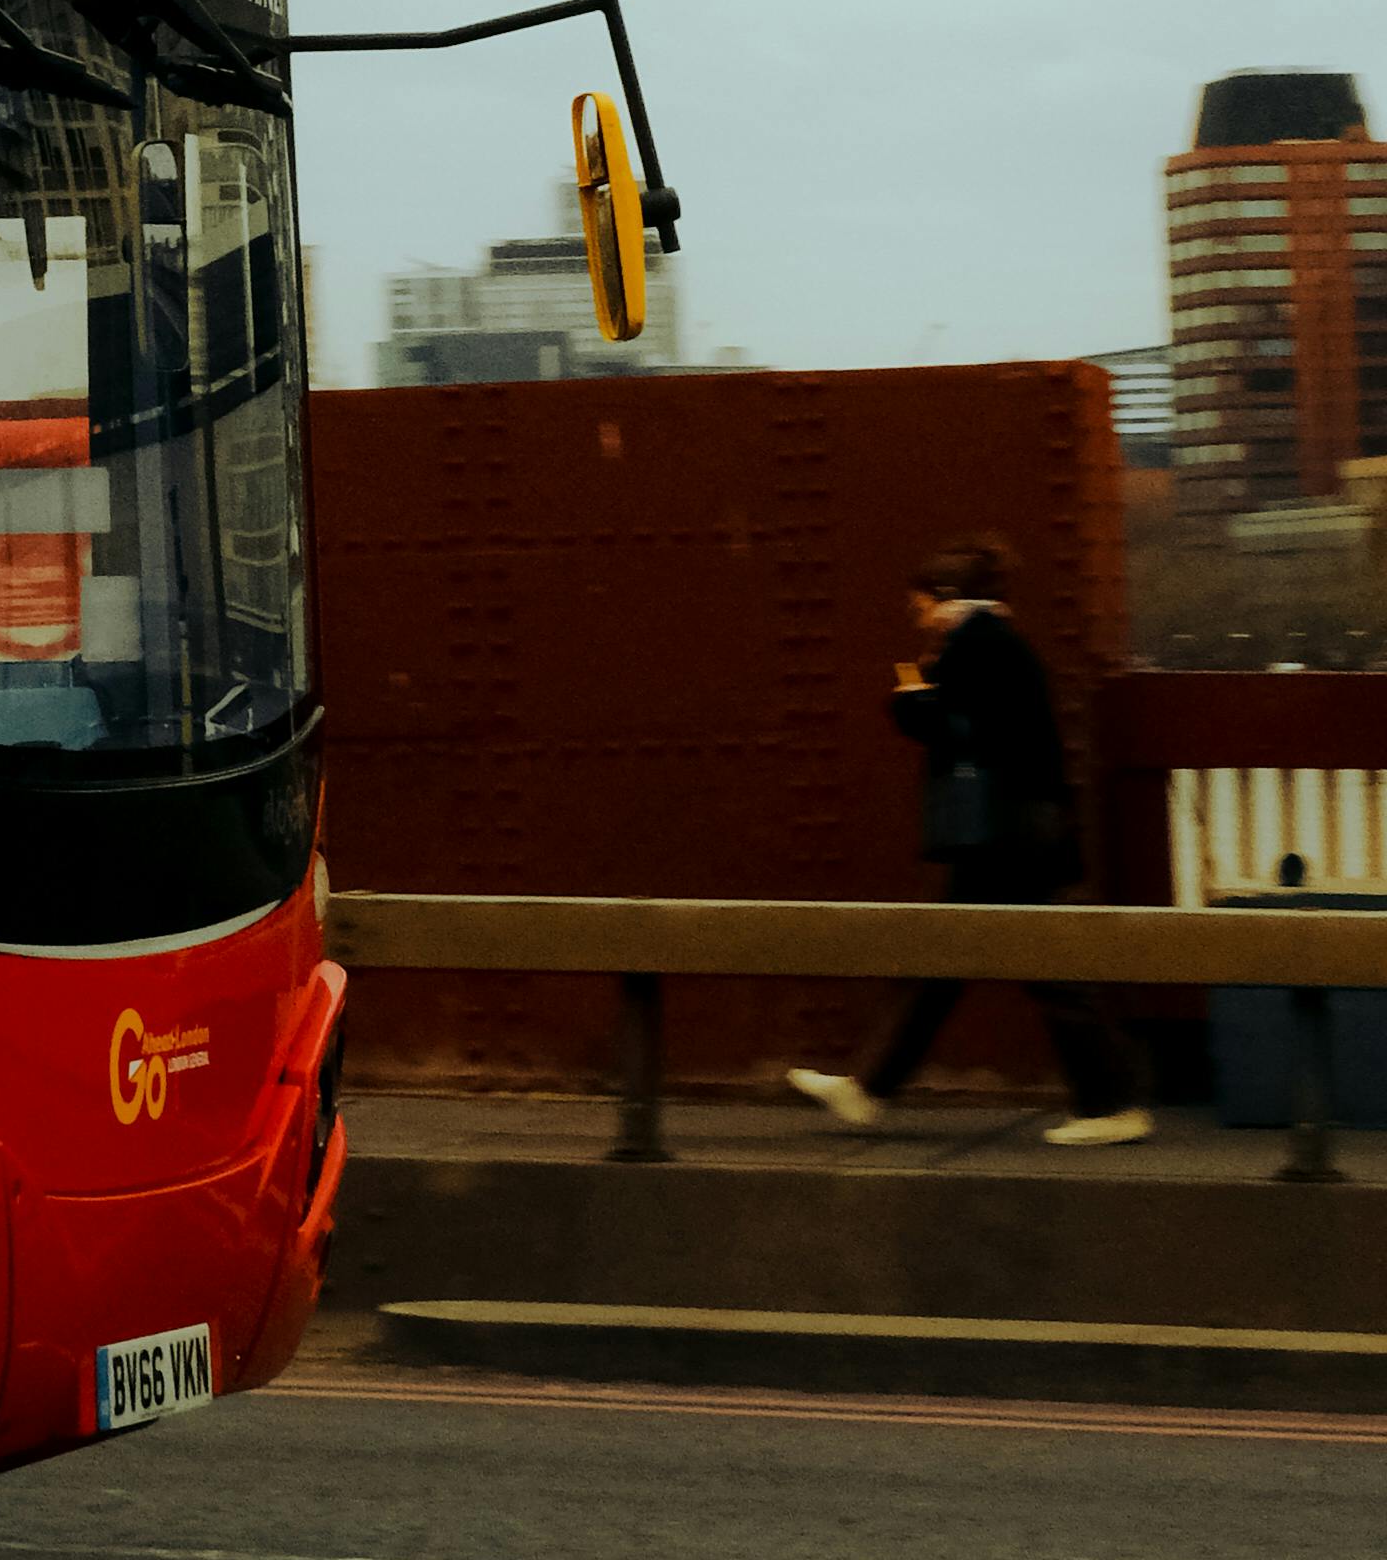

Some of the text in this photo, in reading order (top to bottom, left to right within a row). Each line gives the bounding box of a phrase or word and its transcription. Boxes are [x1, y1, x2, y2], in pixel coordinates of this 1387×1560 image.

[110, 1008, 167, 1125] Go
[112, 1335, 209, 1416] BV66 VKN
